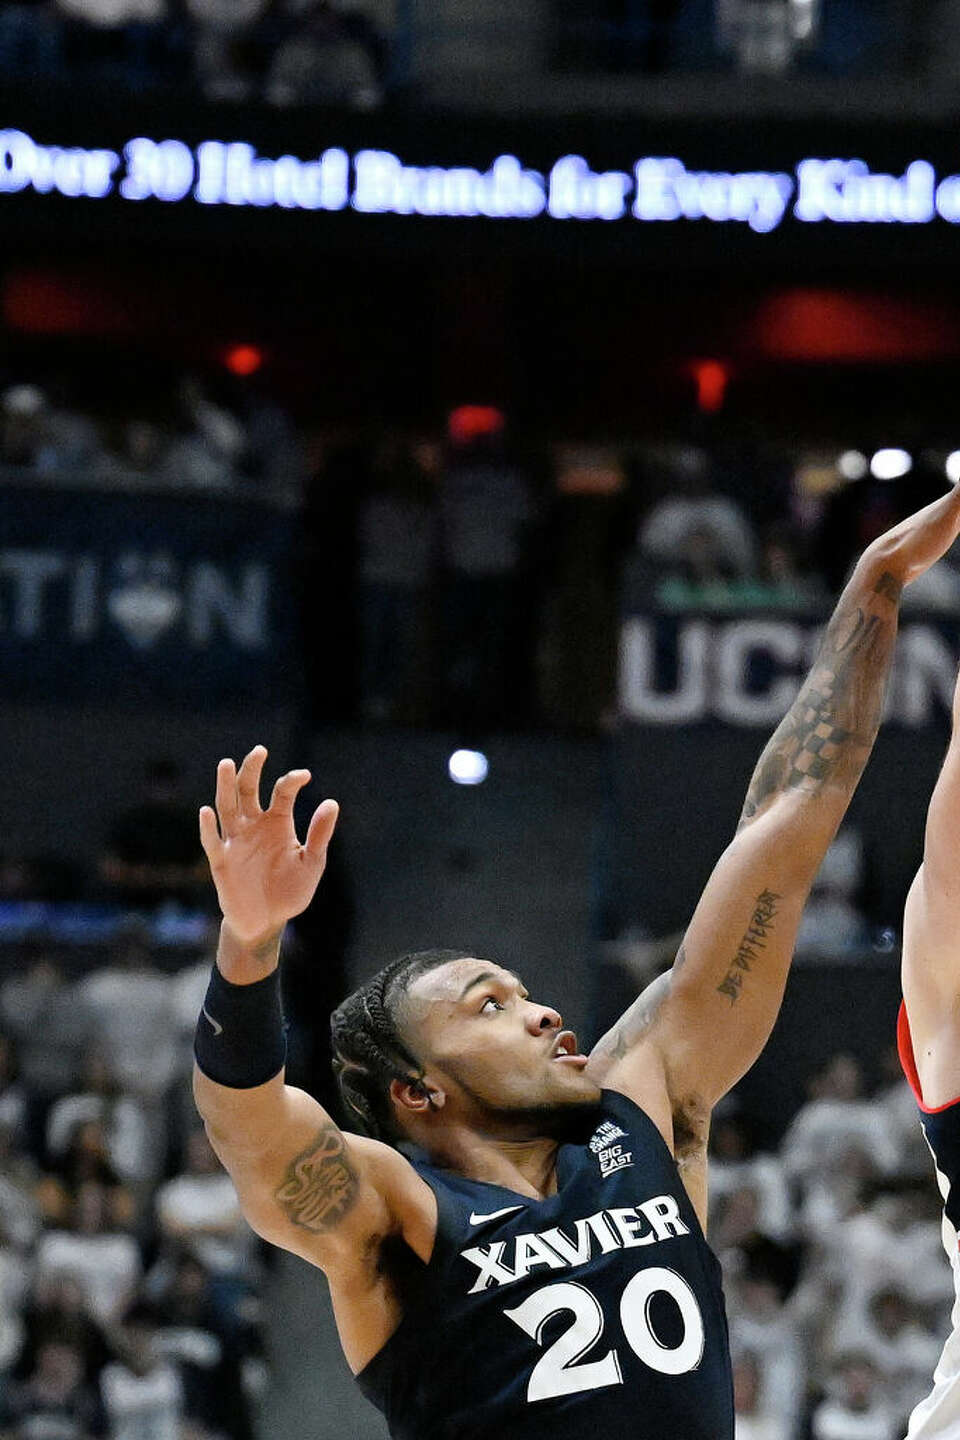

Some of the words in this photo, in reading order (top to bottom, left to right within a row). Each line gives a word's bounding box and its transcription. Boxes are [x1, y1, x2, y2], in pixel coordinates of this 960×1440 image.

[548, 154, 631, 219] for
[633, 156, 792, 233] Every
[794, 158, 935, 223] Kind
[596, 1121, 615, 1135] THE
[598, 1144, 622, 1163] BIG
[601, 1152, 633, 1173] EAST
[459, 1194, 690, 1295] XAVIER
[503, 1266, 706, 1403] 20
